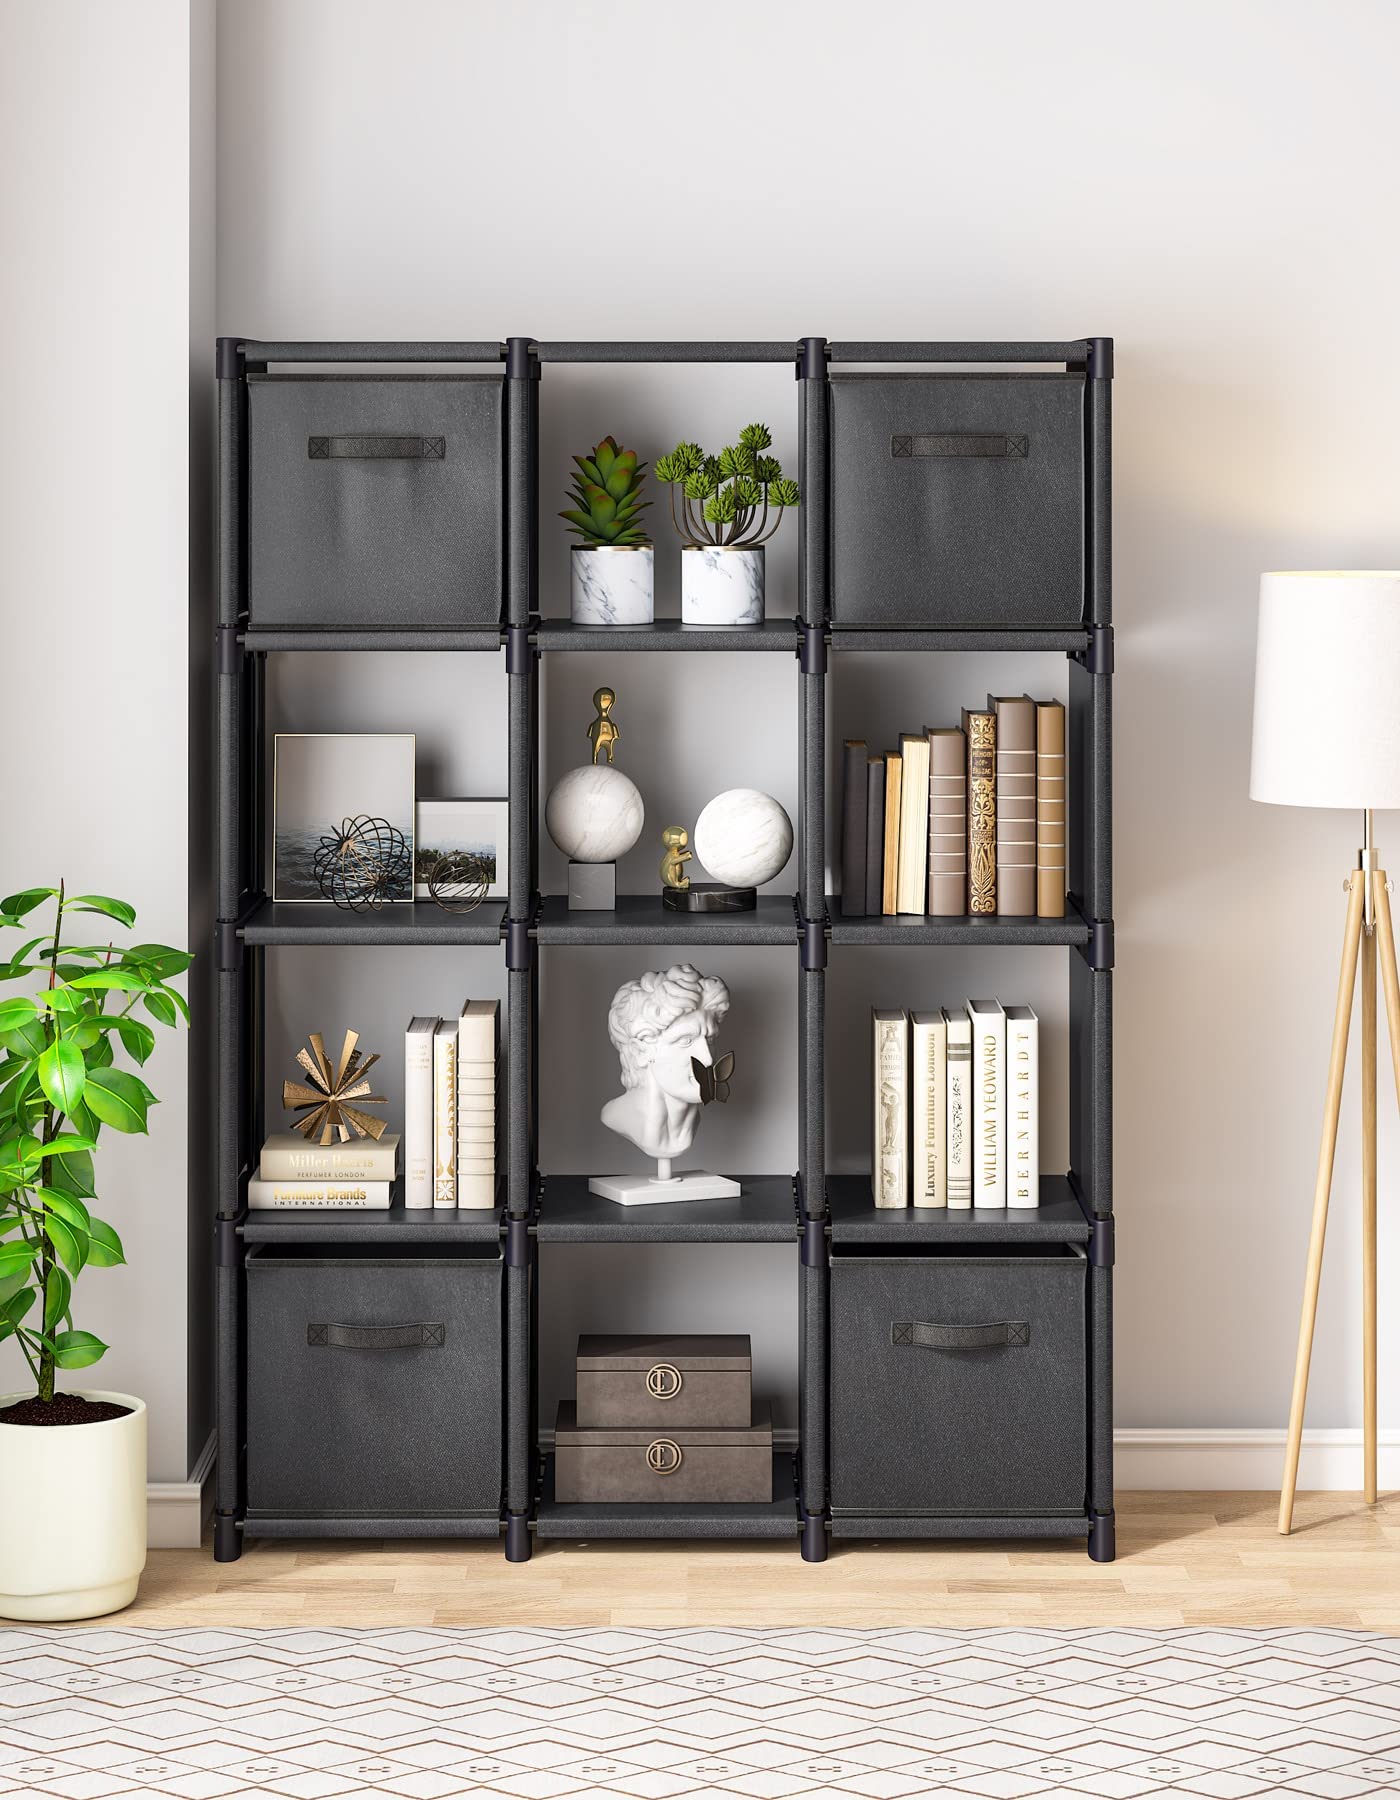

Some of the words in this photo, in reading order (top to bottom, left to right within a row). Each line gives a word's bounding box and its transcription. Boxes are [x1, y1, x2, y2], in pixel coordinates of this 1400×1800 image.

[926, 1033, 935, 1082] London
[983, 1035, 997, 1114] YEOWARD
[925, 1085, 936, 1148] Furniture
[1017, 1032, 1029, 1198] BERNHARDT
[289, 1153, 329, 1168] Miller
[925, 1152, 938, 1197] Luxury
[983, 1120, 997, 1187] WILLIAM
[273, 1187, 324, 1200] Furniture
[326, 1187, 367, 1200] Brands
